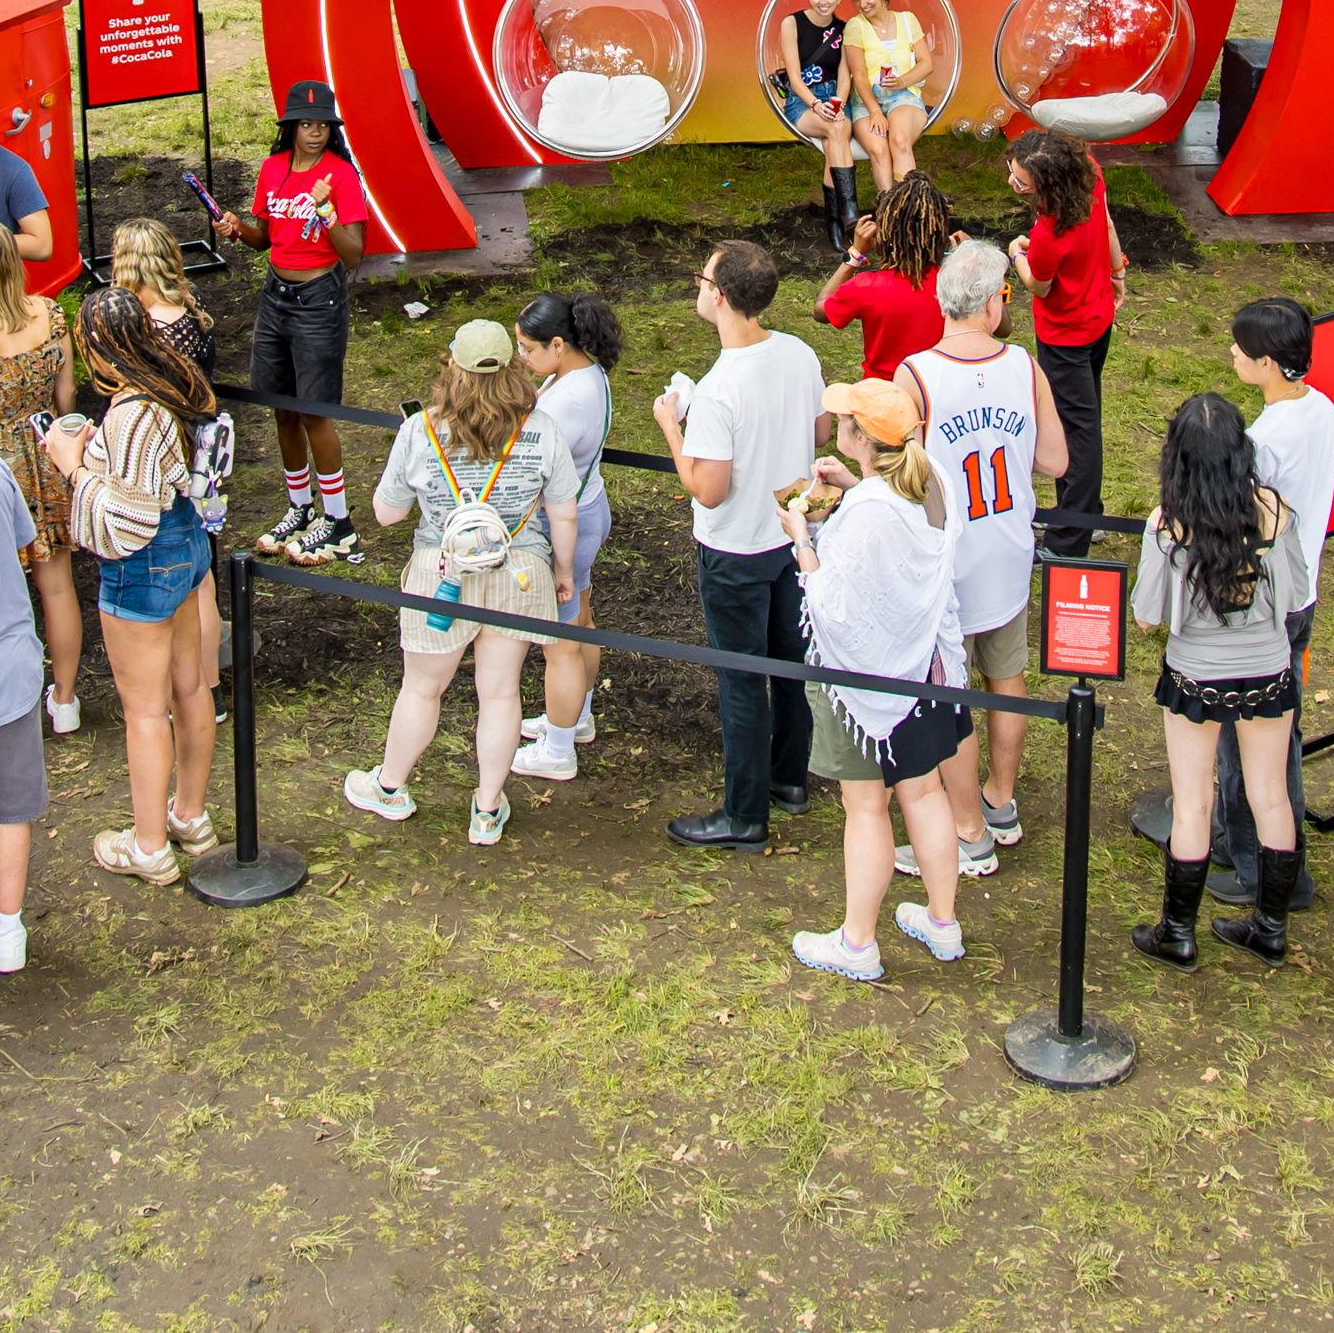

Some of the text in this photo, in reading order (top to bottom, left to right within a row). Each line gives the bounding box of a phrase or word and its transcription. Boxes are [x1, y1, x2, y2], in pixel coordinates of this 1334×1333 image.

[108, 13, 170, 28] Share your
[100, 24, 180, 41] unforgettable
[99, 35, 182, 54] moments with
[111, 49, 173, 65] #CocaCola
[939, 407, 1026, 444] BRUNSON
[962, 445, 1014, 521] 11
[1056, 601, 1110, 612] FILMING NOTICE
